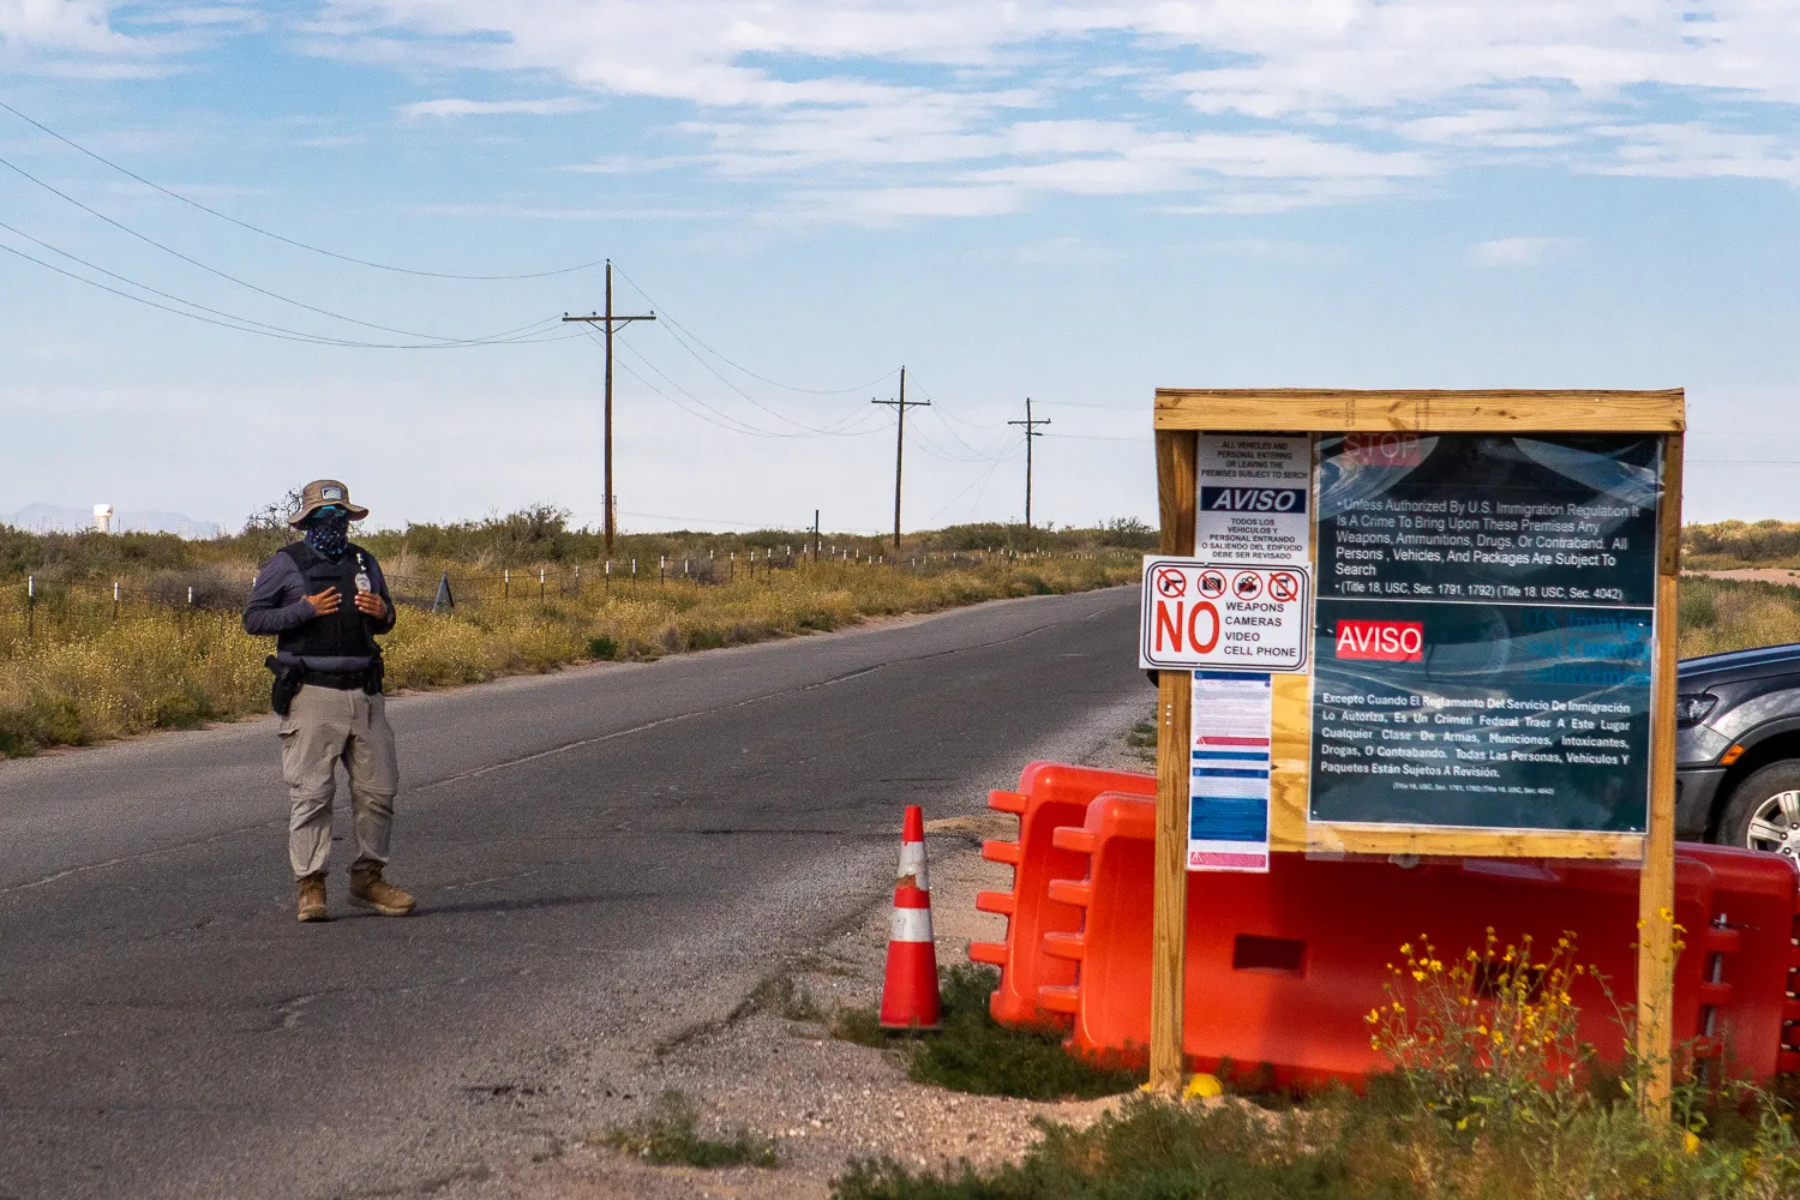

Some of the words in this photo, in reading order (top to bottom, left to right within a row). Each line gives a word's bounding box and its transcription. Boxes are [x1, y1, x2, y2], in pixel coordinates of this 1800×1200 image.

[1343, 432, 1418, 458] STOP
[1201, 469, 1236, 477] PREMISES
[1239, 470, 1272, 478] SUBJECT
[1212, 489, 1296, 511] AVISO
[1344, 500, 1382, 511] Unless
[1385, 501, 1446, 512] Authorized
[1450, 501, 1465, 515] By
[1468, 502, 1492, 513] U.S.
[1497, 502, 1563, 516] Immigration
[1567, 504, 1628, 518] Regulation
[1632, 504, 1639, 517] It
[1337, 515, 1347, 526] Is
[1350, 516, 1358, 527] A
[1361, 515, 1395, 528] Crime
[1398, 516, 1412, 528] To
[1415, 516, 1444, 531] Bring
[1448, 517, 1479, 531] Upon
[1482, 518, 1518, 530] These
[1521, 519, 1574, 532] Premises
[1577, 521, 1600, 535] Any
[1336, 531, 1394, 545] Weapons,
[1396, 533, 1474, 547] Ammunitions,
[1477, 534, 1515, 549] Drugs,
[1518, 536, 1532, 547] Or
[1536, 536, 1606, 549] Contraband.
[1612, 538, 1628, 550] All
[1336, 547, 1383, 560] Persons
[1393, 549, 1445, 563] Vehicles,
[1447, 550, 1470, 562] And
[1473, 551, 1529, 566] Packages
[1532, 553, 1552, 564] Are
[1555, 553, 1599, 568] Subject
[1602, 554, 1616, 566] To
[1335, 563, 1376, 575] Search
[1226, 602, 1284, 613] WEAPONS
[1155, 600, 1220, 654] NO
[1225, 616, 1282, 627] CAMERAS
[1225, 632, 1260, 641] VIDEO
[1337, 626, 1422, 654] AVISO
[1224, 646, 1253, 656] CELL
[1256, 647, 1296, 657] PHONE
[1323, 693, 1364, 704] Excepto
[1367, 695, 1407, 706] Cuando
[1410, 696, 1420, 706] El
[1422, 696, 1484, 709] Reglamento
[1487, 698, 1505, 709] Del
[1507, 699, 1549, 710] Servicio
[1551, 701, 1566, 711] De
[1568, 701, 1631, 714] Inmigración
[1322, 711, 1335, 720] Lo
[1342, 712, 1388, 723] Autoriza,
[1394, 713, 1407, 723] Es
[1414, 713, 1428, 723] Un
[1435, 714, 1473, 725] Crimen
[1480, 716, 1518, 726] Federal
[1525, 717, 1550, 727] Traer
[1557, 718, 1565, 728] A
[1572, 719, 1595, 729] Este
[1601, 720, 1630, 732] Lugar
[1322, 728, 1373, 740] Cualquier
[1382, 729, 1411, 740] Clase
[1420, 731, 1435, 741] De
[1443, 732, 1480, 743] Armas,
[1489, 733, 1552, 745] Municiones,
[1562, 736, 1629, 748] Intoxicantes,
[1322, 745, 1361, 757] Drogas,
[1365, 746, 1373, 755] O
[1377, 746, 1447, 758] Contrabando.
[1456, 749, 1485, 759] Todas
[1490, 751, 1507, 760] Las
[1511, 751, 1562, 763] Personas,
[1622, 755, 1630, 764] Y
[1321, 762, 1368, 773] Paquetes
[1372, 763, 1400, 774] Están
[1403, 765, 1441, 777] Sujetos
[1443, 766, 1450, 775] A
[1453, 766, 1500, 777] Revisión.
